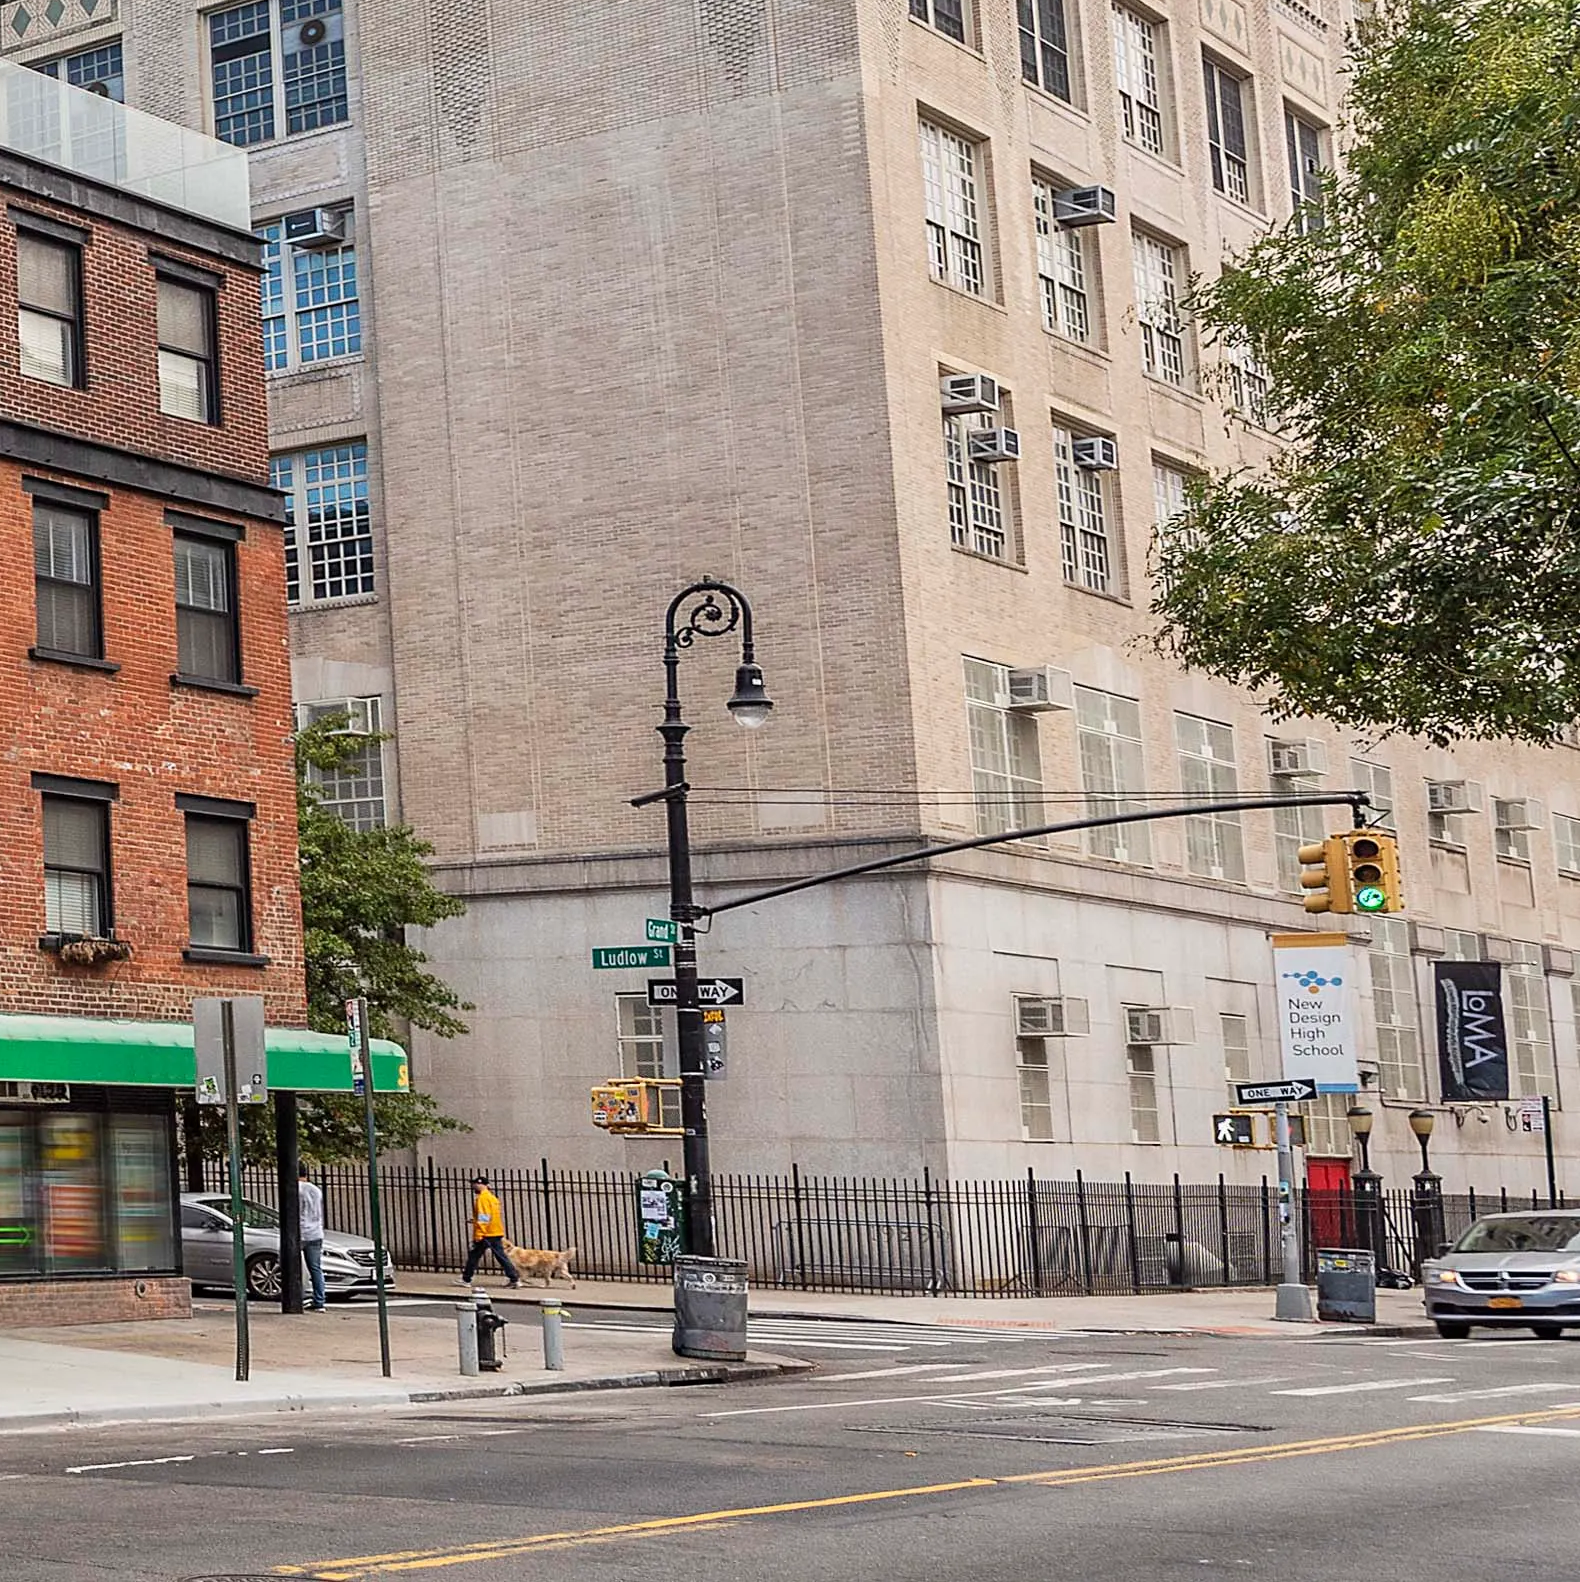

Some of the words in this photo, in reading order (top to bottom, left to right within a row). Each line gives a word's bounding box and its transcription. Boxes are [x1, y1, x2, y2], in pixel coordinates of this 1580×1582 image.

[648, 920, 669, 940] Grand
[601, 950, 648, 966] Ludlow
[653, 949, 663, 959] St
[661, 986, 677, 997] ON
[699, 986, 729, 998] WAY
[1288, 998, 1323, 1010] New
[1289, 1012, 1341, 1026] Design
[1290, 1027, 1326, 1042] High
[1292, 1044, 1344, 1056] School
[1248, 1088, 1271, 1098] ONE
[1280, 1086, 1303, 1096] WAY
